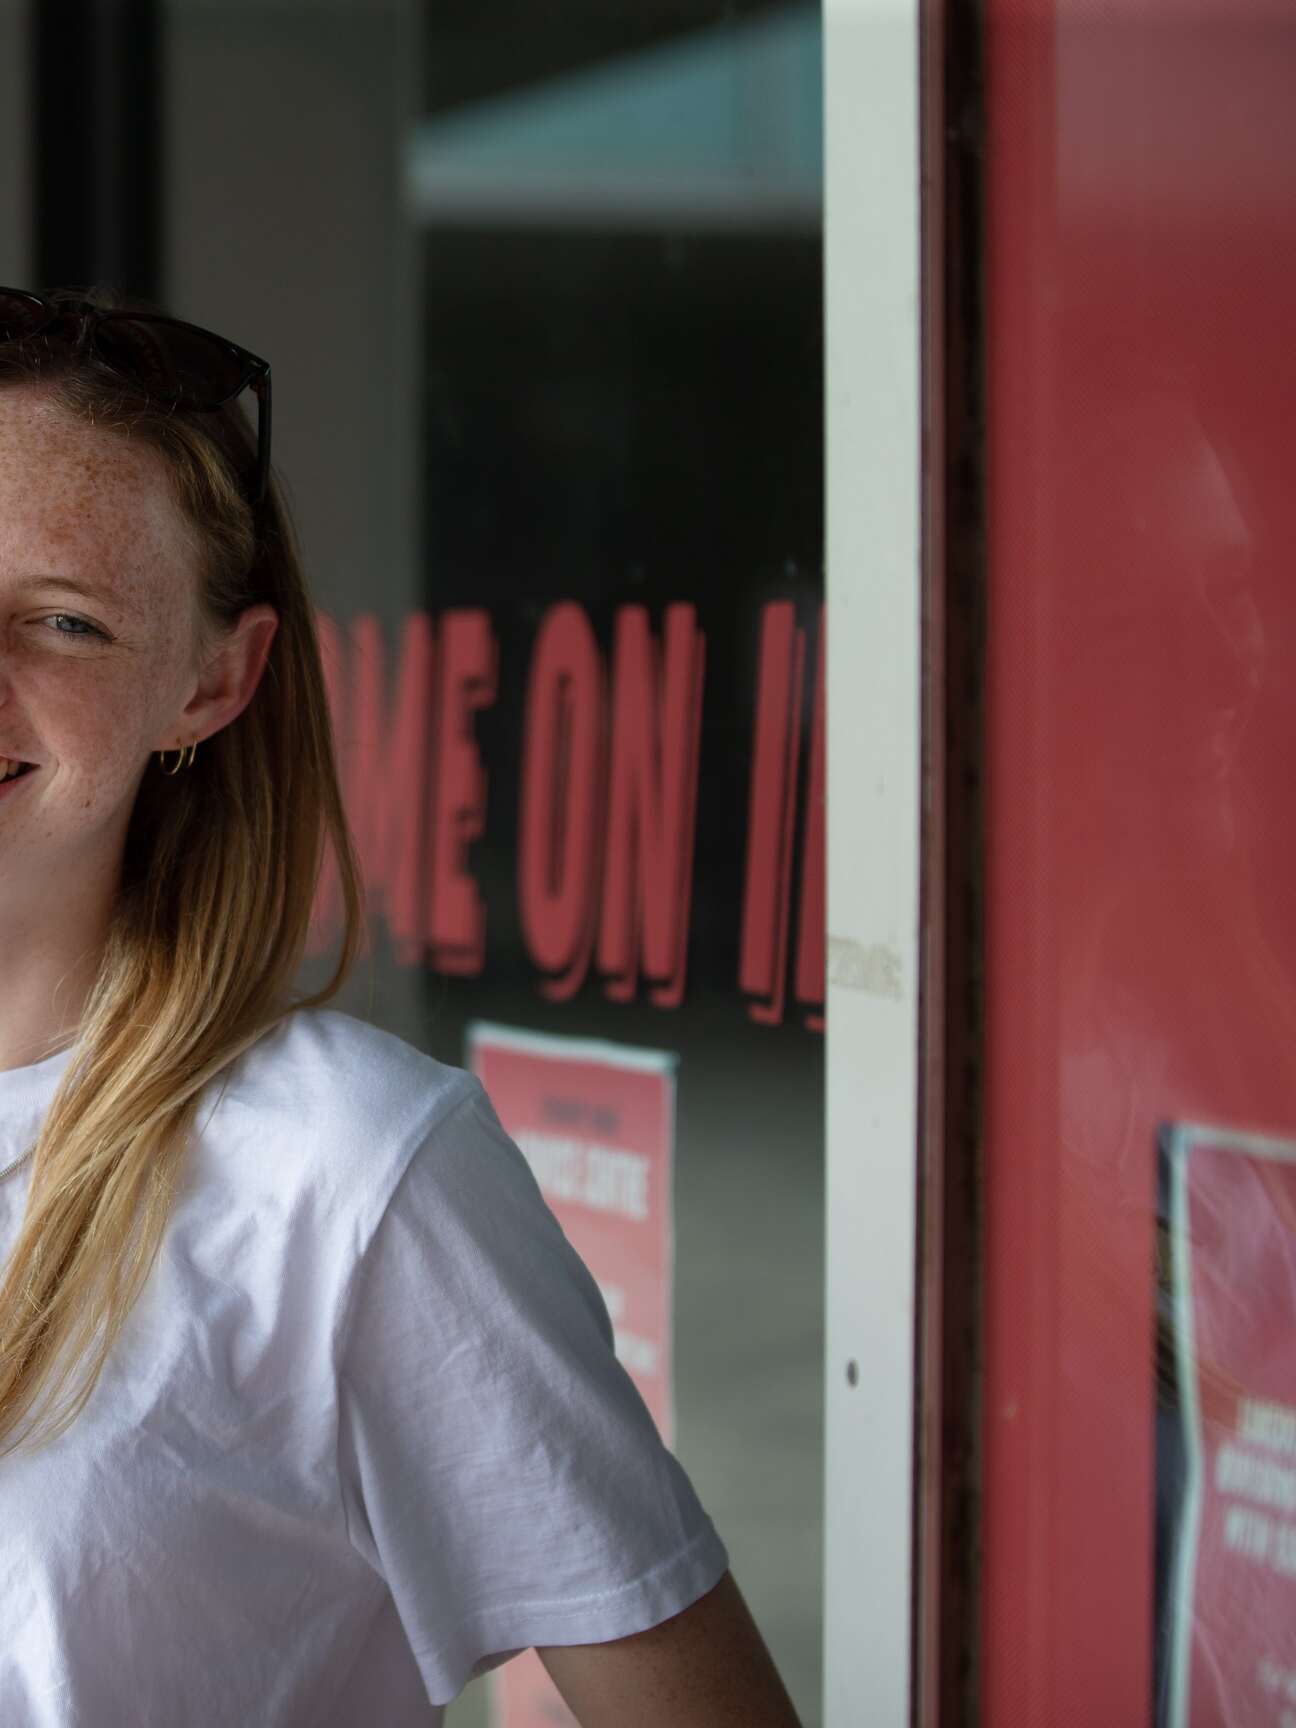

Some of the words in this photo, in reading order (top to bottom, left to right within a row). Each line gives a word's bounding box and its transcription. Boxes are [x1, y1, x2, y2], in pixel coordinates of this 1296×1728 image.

[308, 608, 498, 976] ME
[518, 600, 705, 1008] ON
[740, 600, 826, 1032] I
